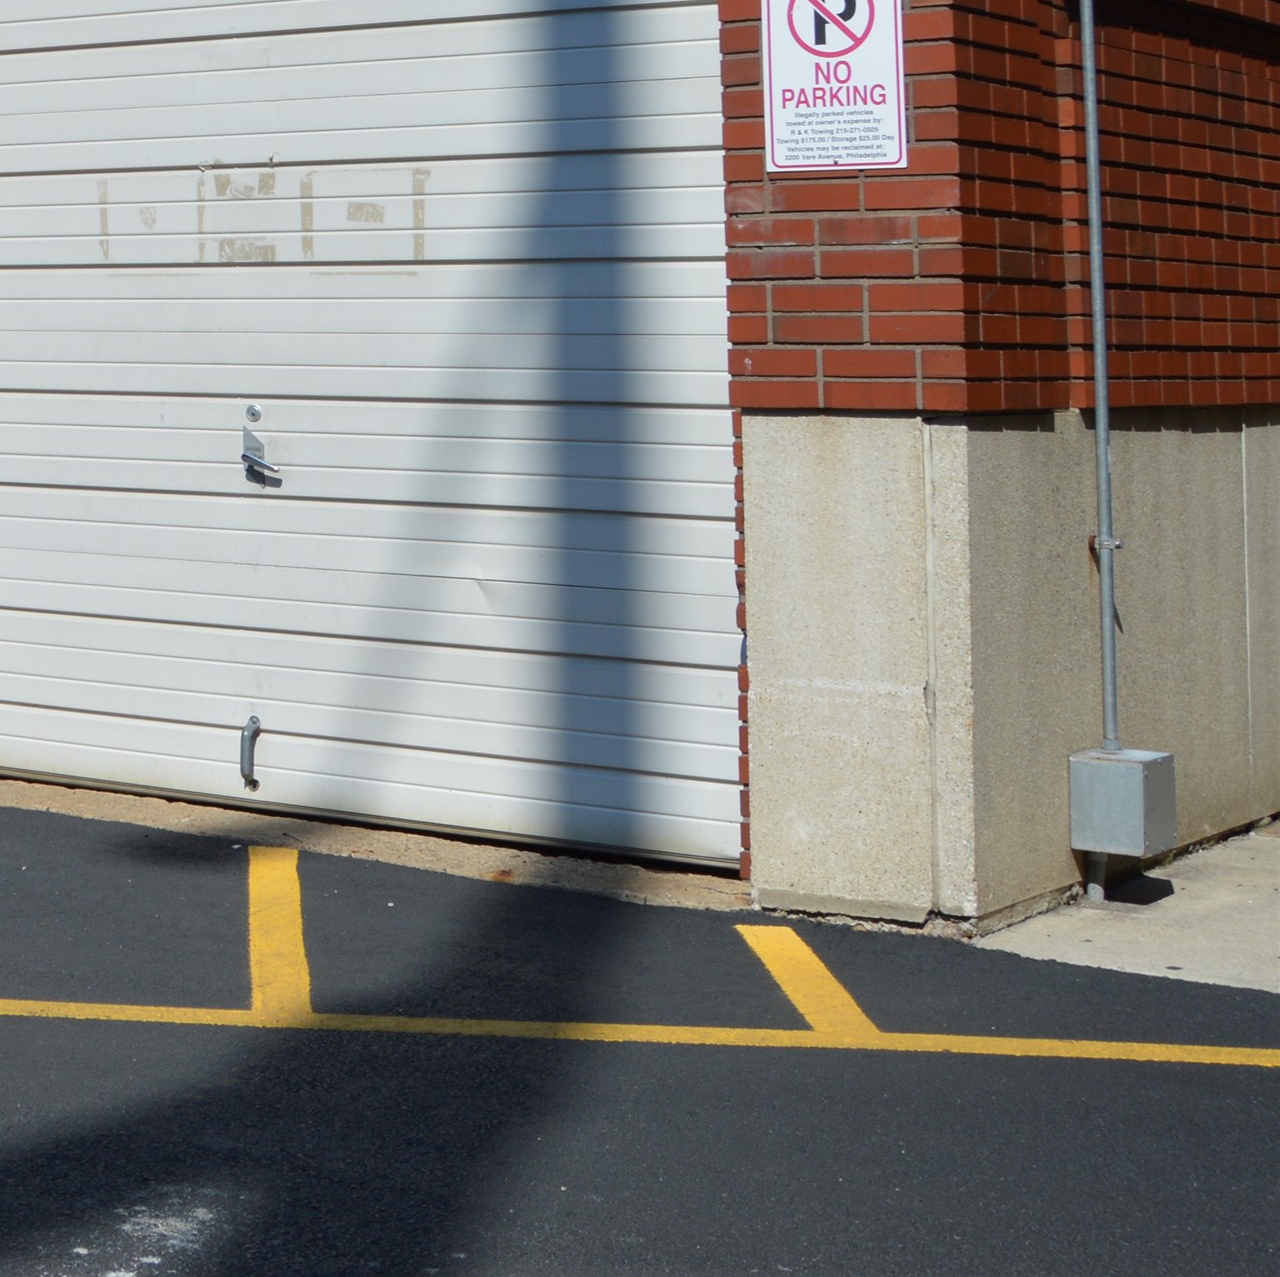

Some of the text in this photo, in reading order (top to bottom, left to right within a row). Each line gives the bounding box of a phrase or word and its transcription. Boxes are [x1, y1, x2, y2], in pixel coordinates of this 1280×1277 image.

[814, 60, 852, 85] NO
[781, 84, 887, 109] PARKING
[811, 128, 834, 136] Towing
[831, 135, 857, 143] Storage
[859, 134, 880, 142] $25.00
